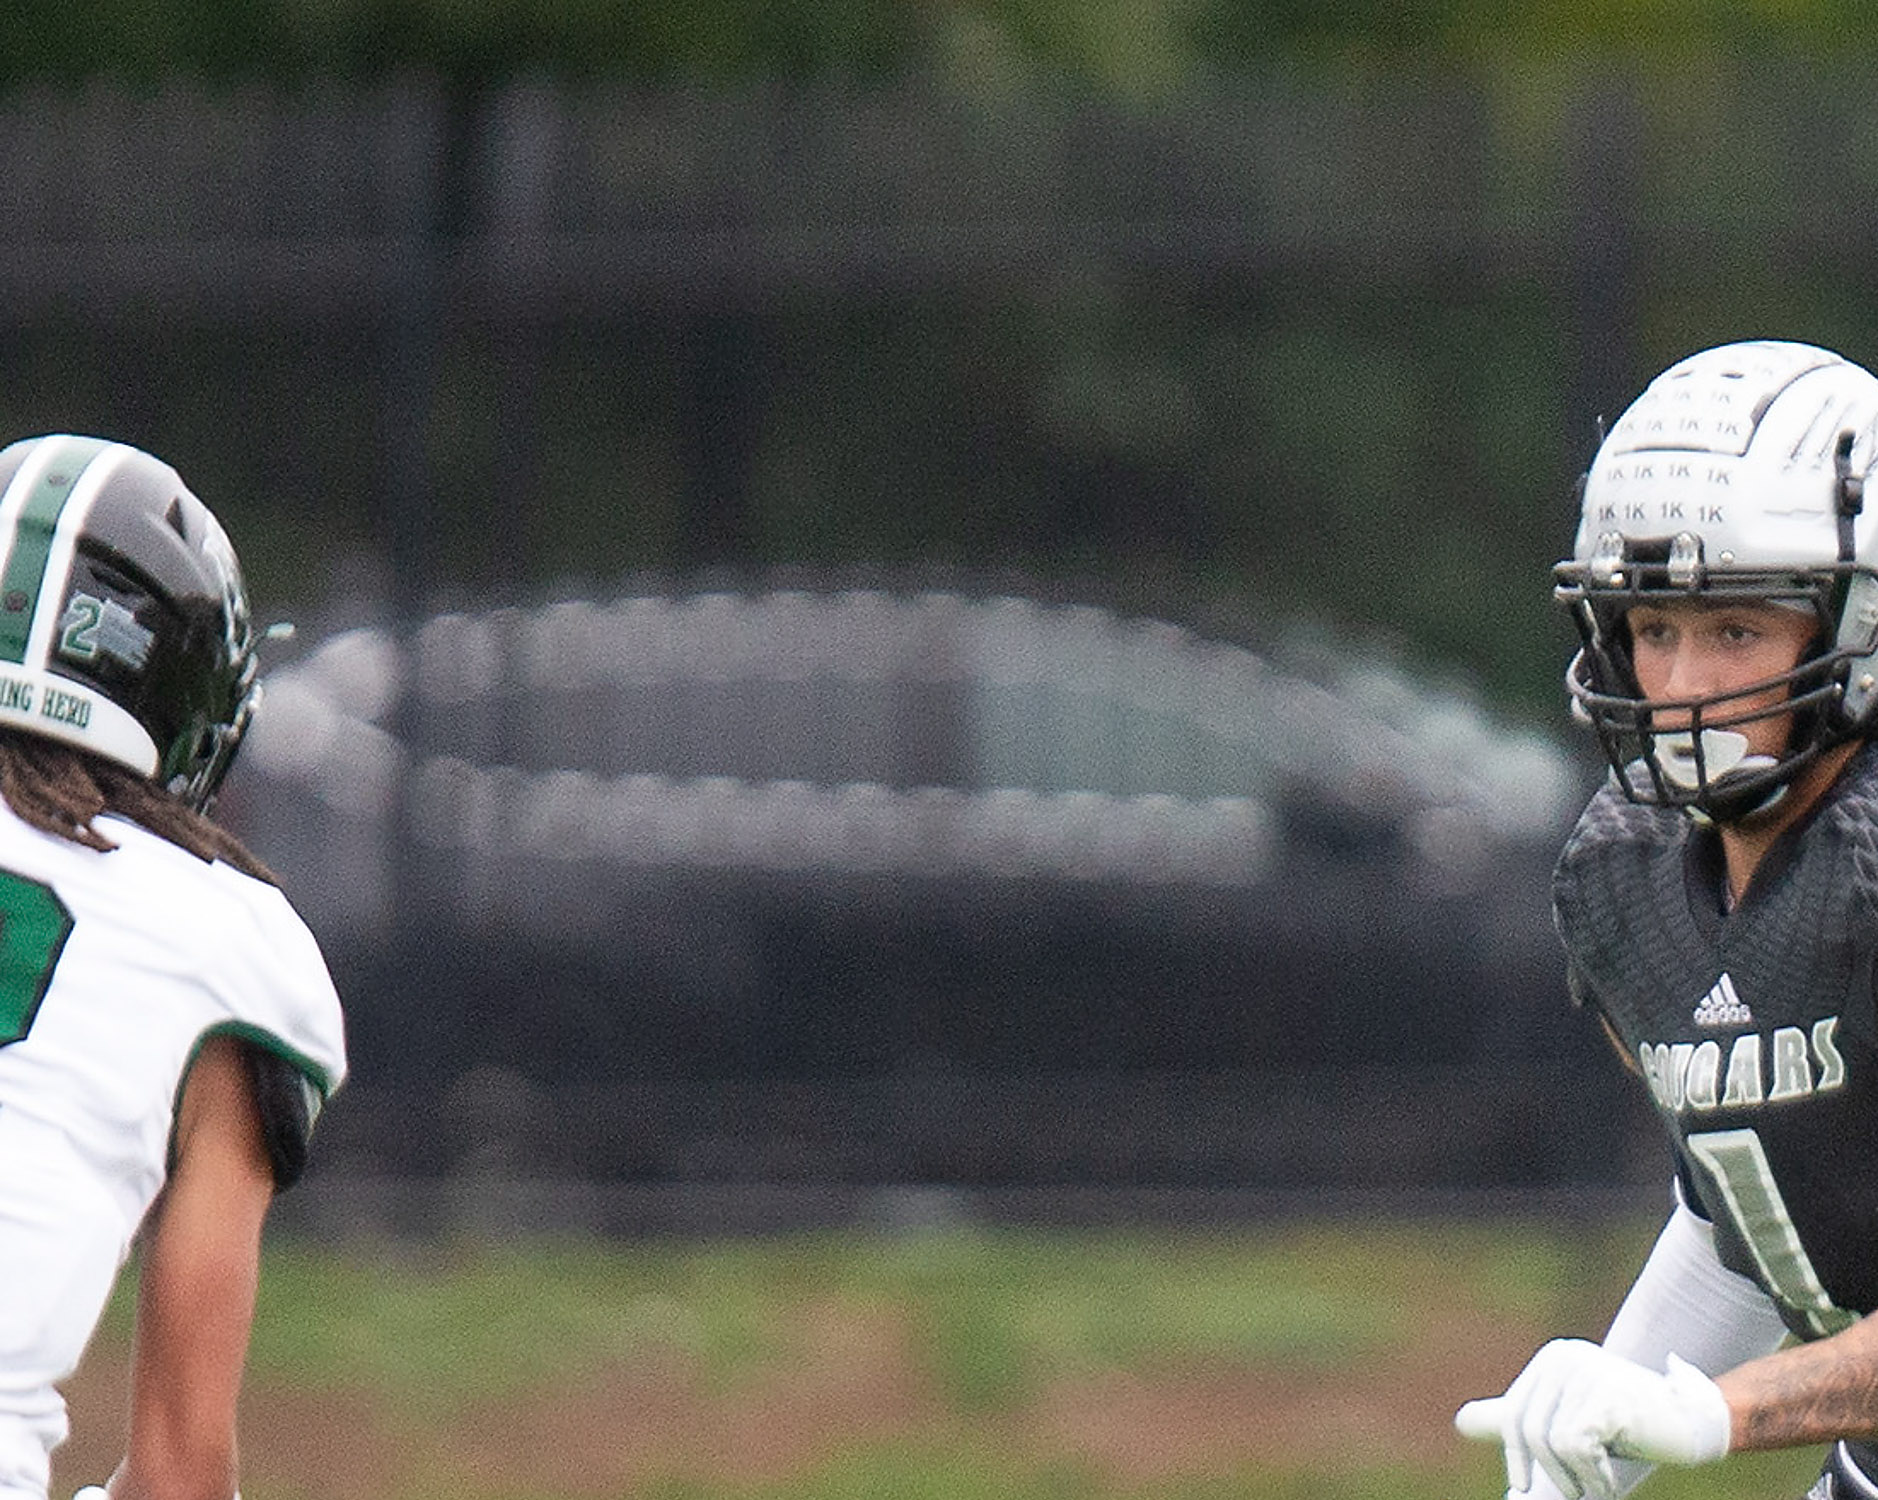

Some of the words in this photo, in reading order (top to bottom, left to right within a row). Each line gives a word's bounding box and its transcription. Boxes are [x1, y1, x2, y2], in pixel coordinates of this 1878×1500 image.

[1634, 464, 1654, 479] 1K
[1669, 463, 1691, 478] 1K
[1707, 467, 1730, 486] 1K
[1598, 502, 1616, 522] 1K
[1624, 501, 1646, 521] 1K
[1661, 501, 1685, 519] 1K
[1698, 505, 1724, 524] 1K
[61, 593, 103, 658] 2
[42, 687, 91, 728] HERD
[1688, 1128, 1863, 1344] 1
